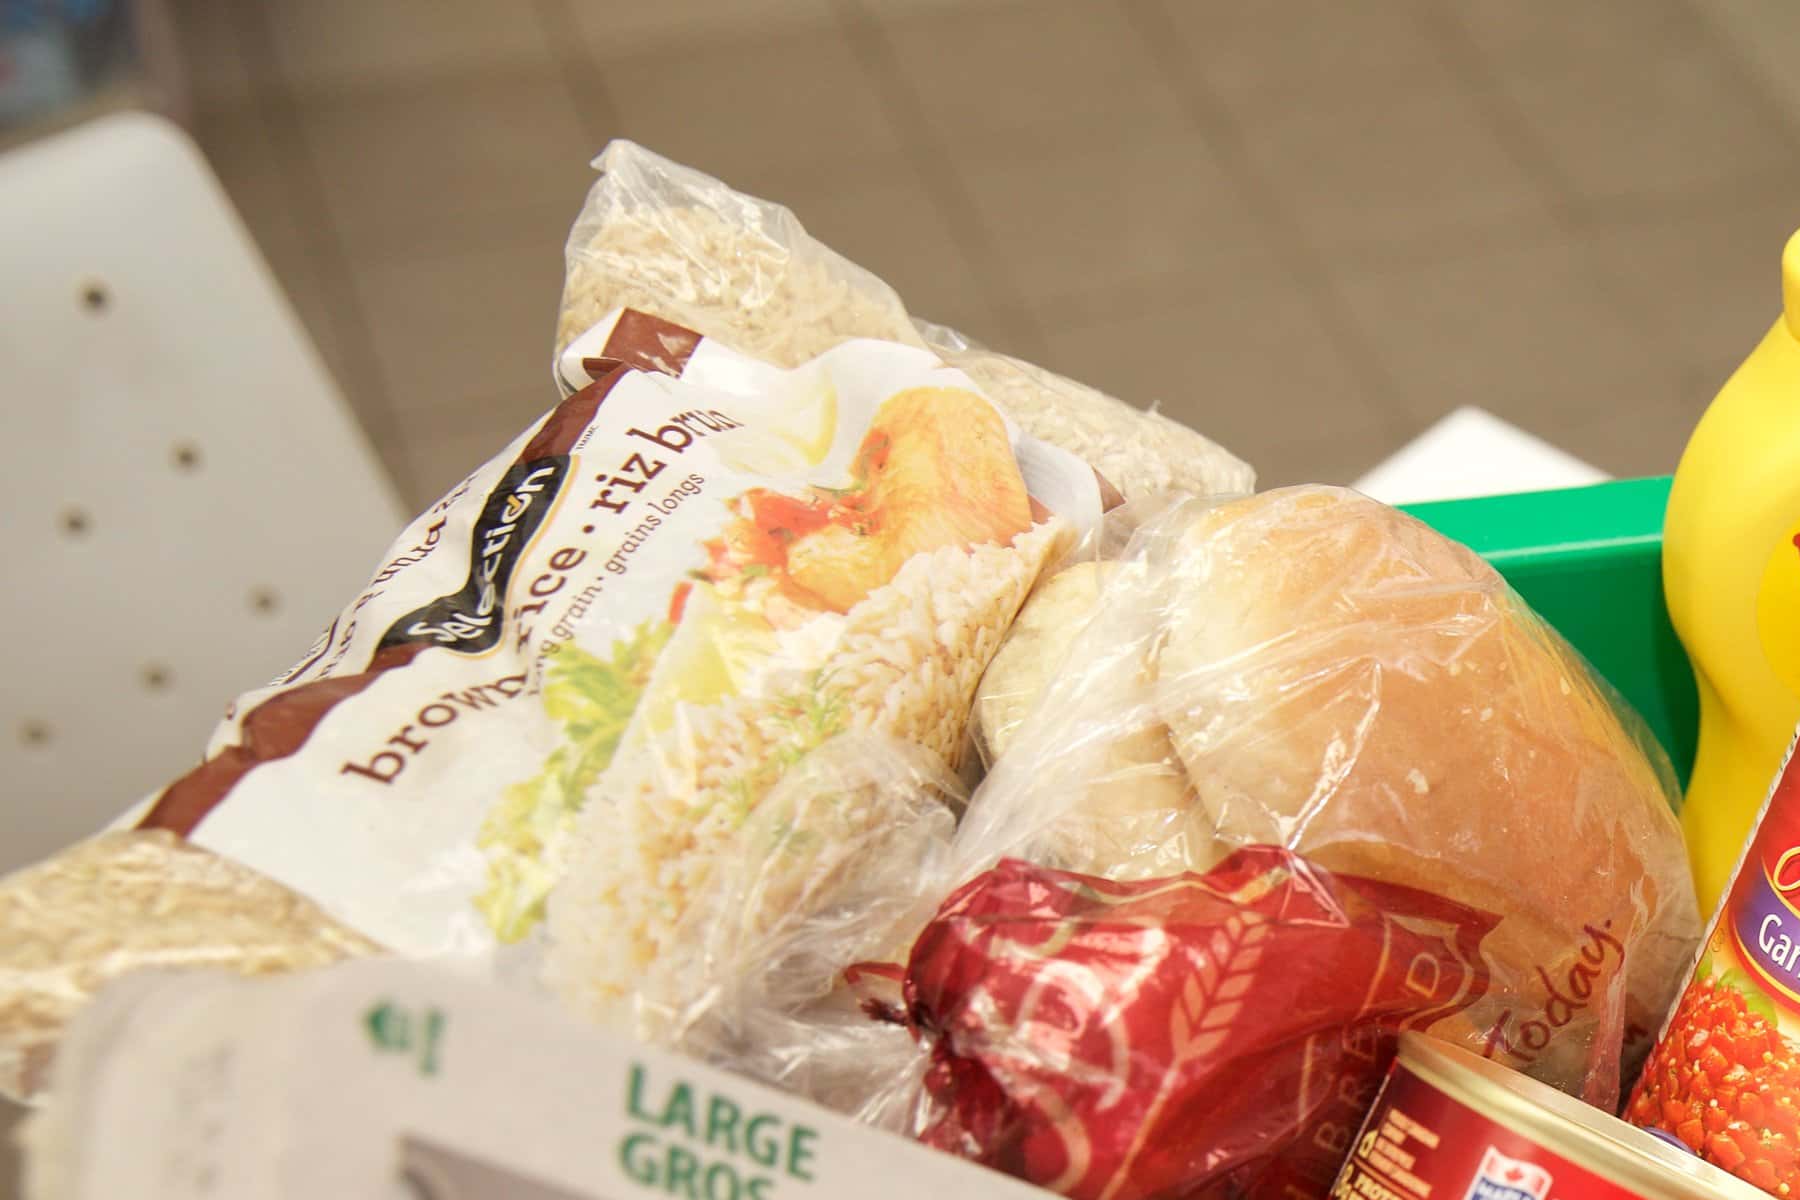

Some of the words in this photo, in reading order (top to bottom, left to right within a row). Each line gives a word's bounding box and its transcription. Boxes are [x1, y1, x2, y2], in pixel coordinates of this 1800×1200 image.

[591, 452, 667, 515] riz
[625, 408, 747, 454] brun
[605, 513, 663, 575] grains
[654, 471, 706, 515] longs
[513, 546, 588, 656] rice
[340, 672, 527, 786] brown
[625, 1062, 820, 1182] LARGE
